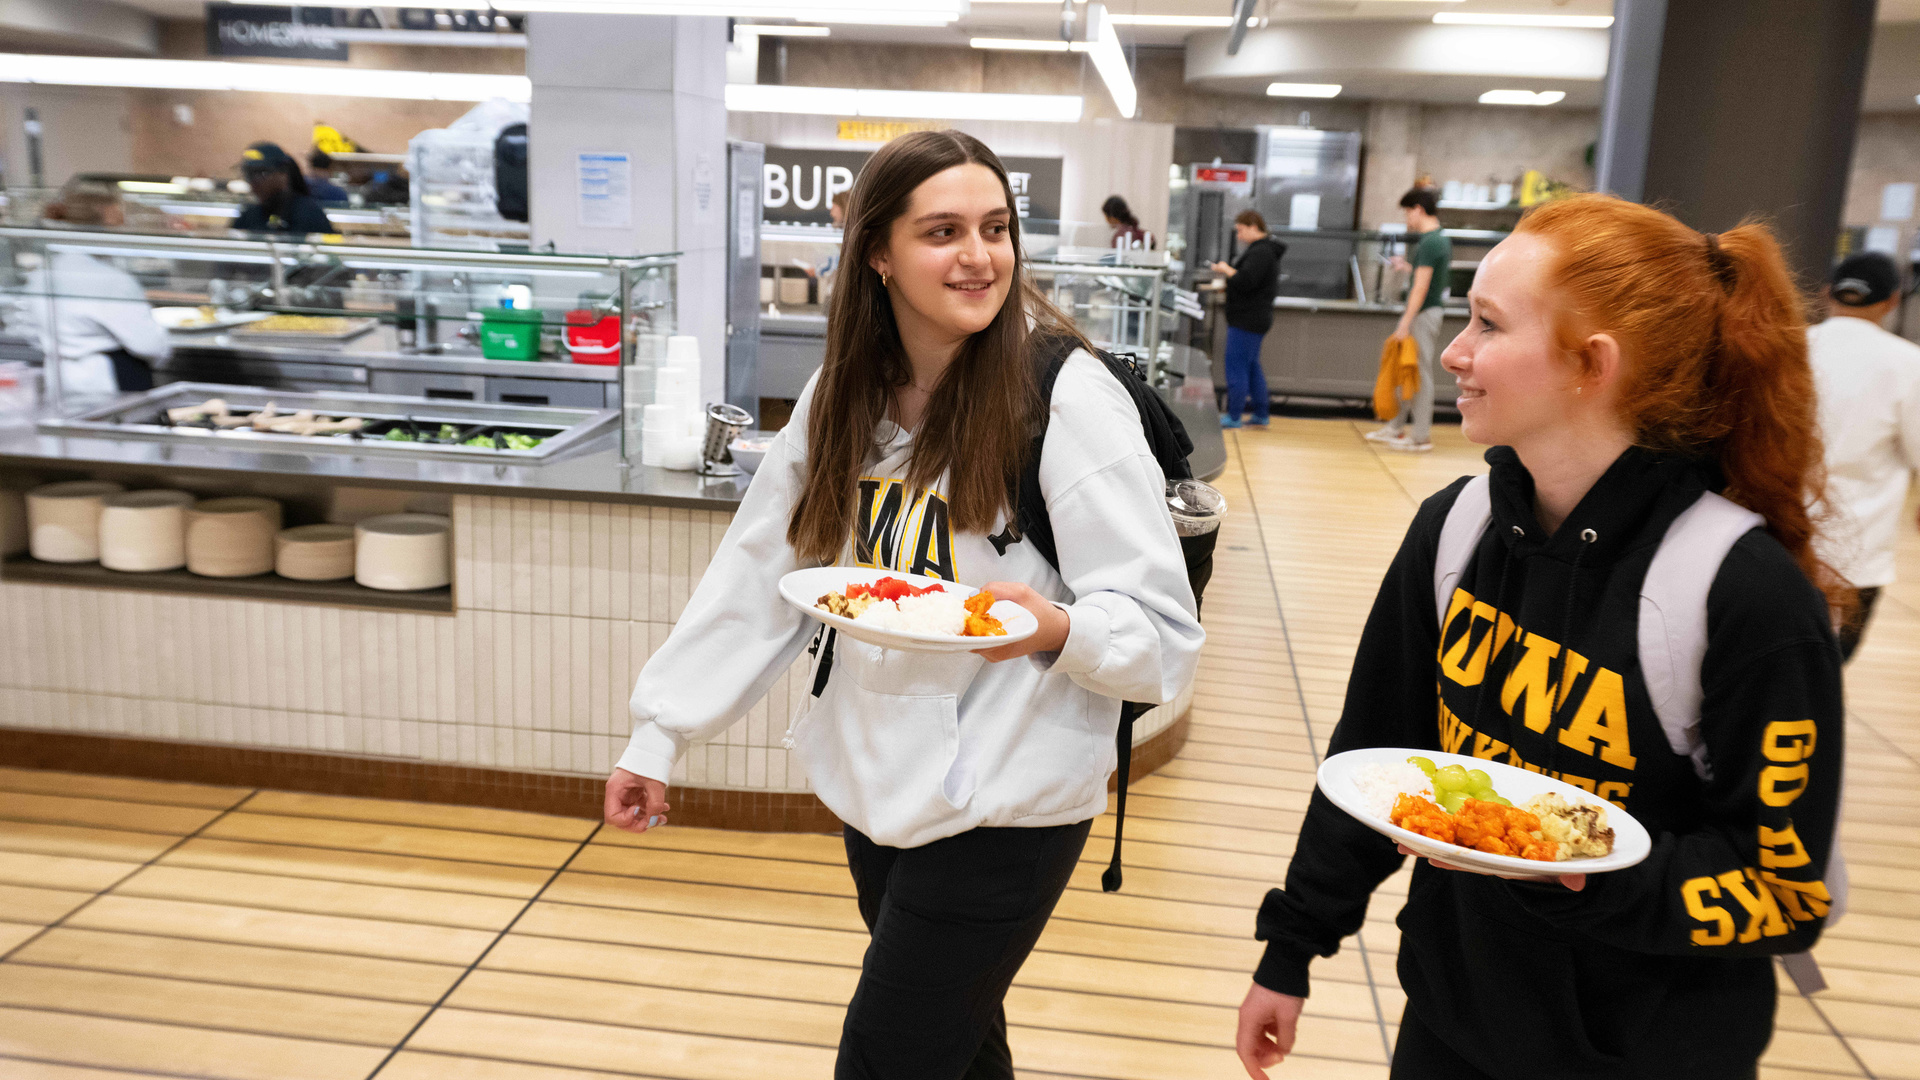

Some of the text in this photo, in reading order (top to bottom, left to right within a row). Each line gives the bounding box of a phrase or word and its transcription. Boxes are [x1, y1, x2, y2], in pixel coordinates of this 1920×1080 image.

[762, 163, 854, 211] BUR
[853, 475, 960, 584] WA
[1437, 587, 1638, 771] IOWA
[1757, 719, 1817, 808] GO
